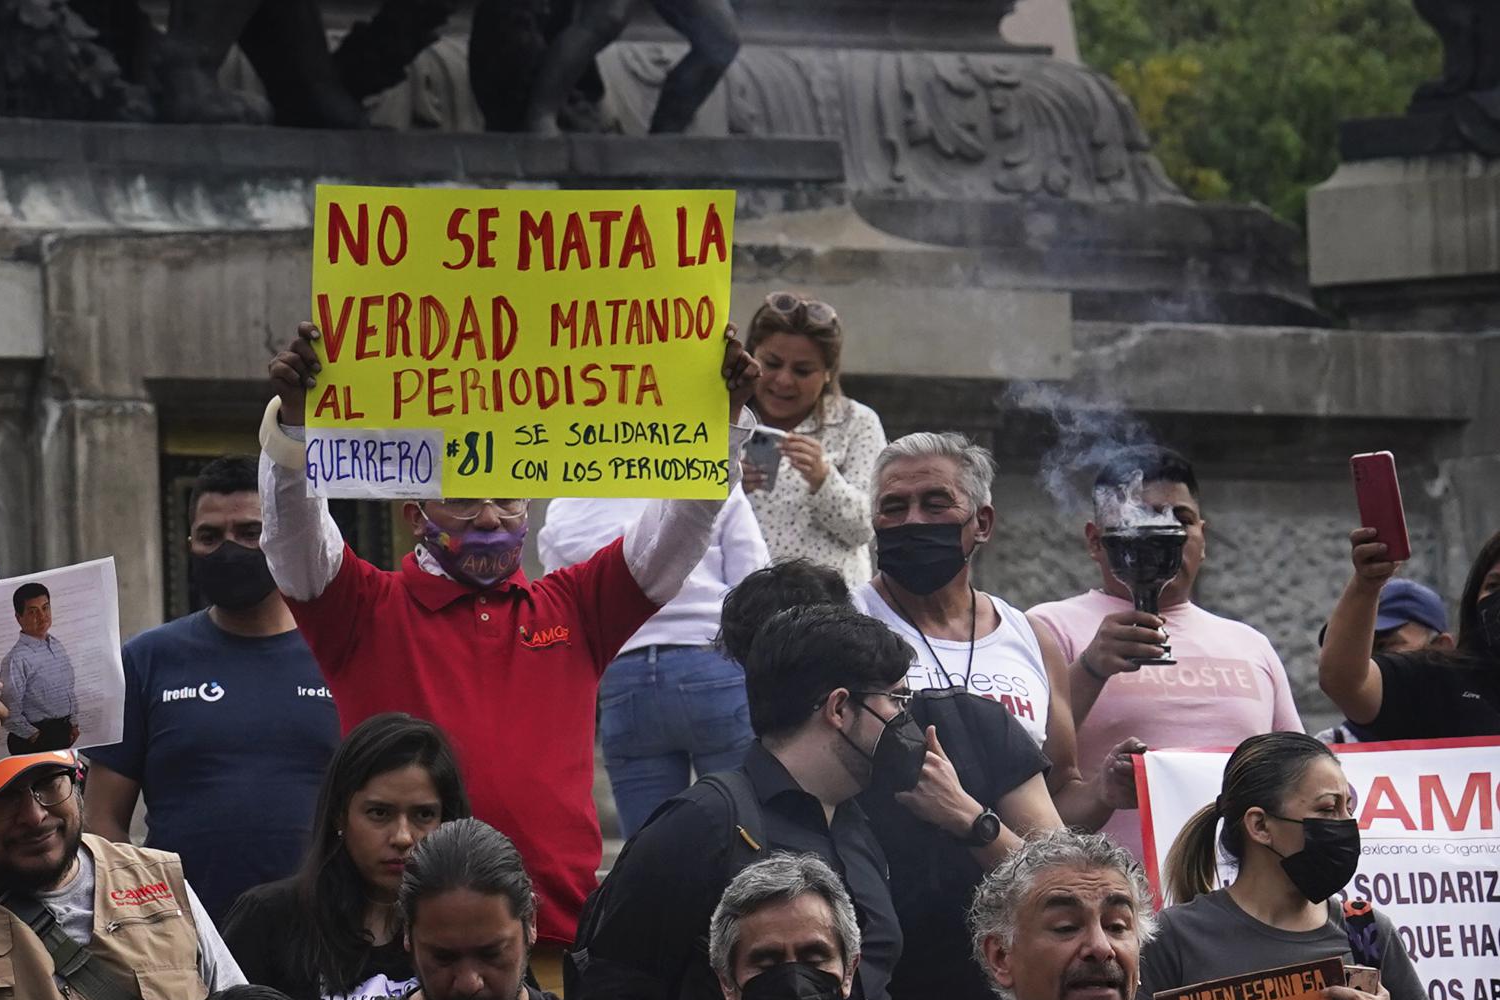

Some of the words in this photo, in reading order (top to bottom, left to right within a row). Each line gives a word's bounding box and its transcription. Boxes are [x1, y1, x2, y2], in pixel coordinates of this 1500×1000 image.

[327, 202, 408, 267] NO
[443, 206, 500, 270] SE
[517, 204, 656, 271] MATA
[677, 202, 728, 268] LA
[316, 291, 519, 364] VERDAD
[550, 295, 715, 350] MATANDO
[313, 384, 365, 421] AL
[392, 363, 664, 420] PERIODISTA
[515, 424, 550, 446] SE
[565, 421, 709, 447] SOLIDARIZA
[306, 437, 434, 489] GUERRERO
[446, 431, 494, 477] #81
[511, 458, 549, 482] CON
[562, 461, 603, 483] LOS
[610, 457, 729, 485] PERIODISTAS
[981, 693, 1036, 721] MH
[1357, 771, 1500, 832] AM
[1359, 842, 1418, 856] exicana
[1398, 924, 1454, 963] QUE
[1458, 924, 1500, 958] HA
